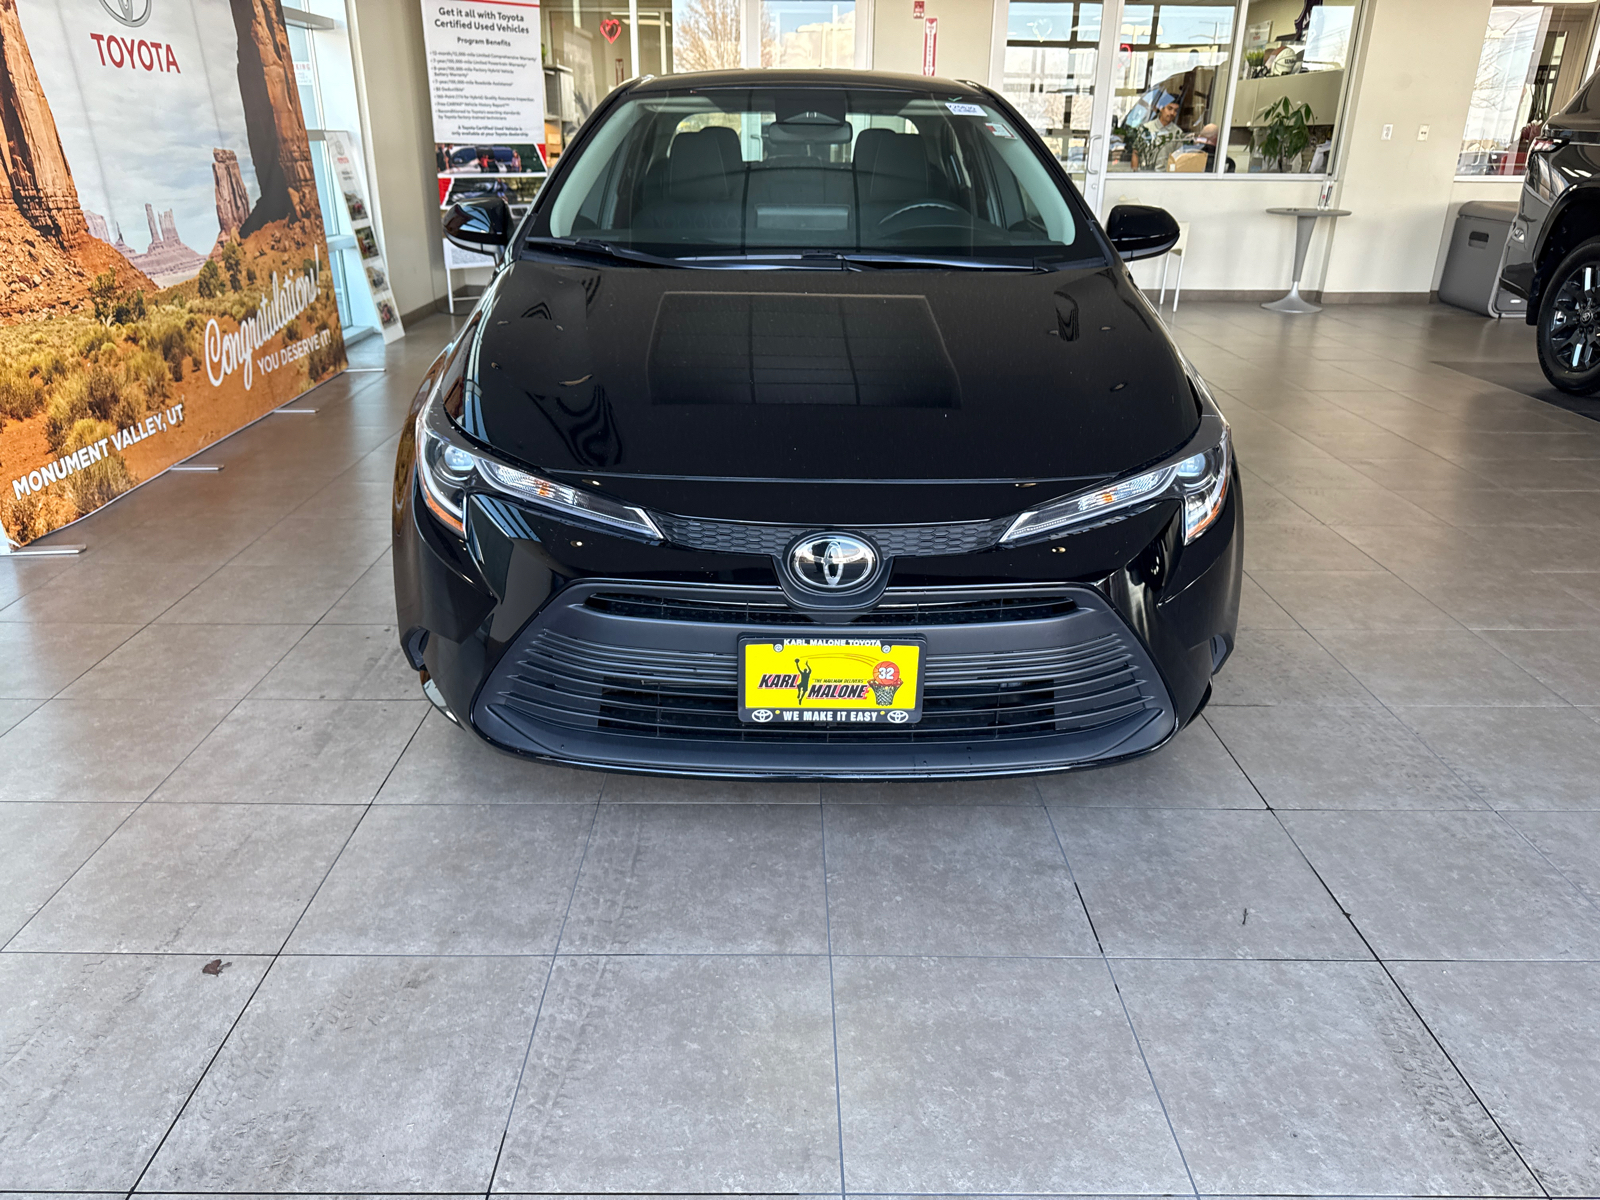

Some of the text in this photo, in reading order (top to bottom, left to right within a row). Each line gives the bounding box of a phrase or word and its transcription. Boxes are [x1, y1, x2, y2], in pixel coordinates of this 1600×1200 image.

[438, 7, 524, 22] Get it all with Toyota
[434, 19, 529, 34] Certified Used Vehicles
[457, 37, 511, 47] Program Benefits
[90, 32, 181, 74] TOYOTA
[205, 243, 321, 391] Congratulations!
[257, 329, 331, 375] YOU DESERVE IT!
[12, 404, 183, 500] MONUMENT VALLEY, UT
[878, 667, 894, 680] 32
[758, 674, 798, 689] KARL
[806, 684, 868, 699] MALONE
[783, 712, 877, 721] WE MAKE IT EASY
